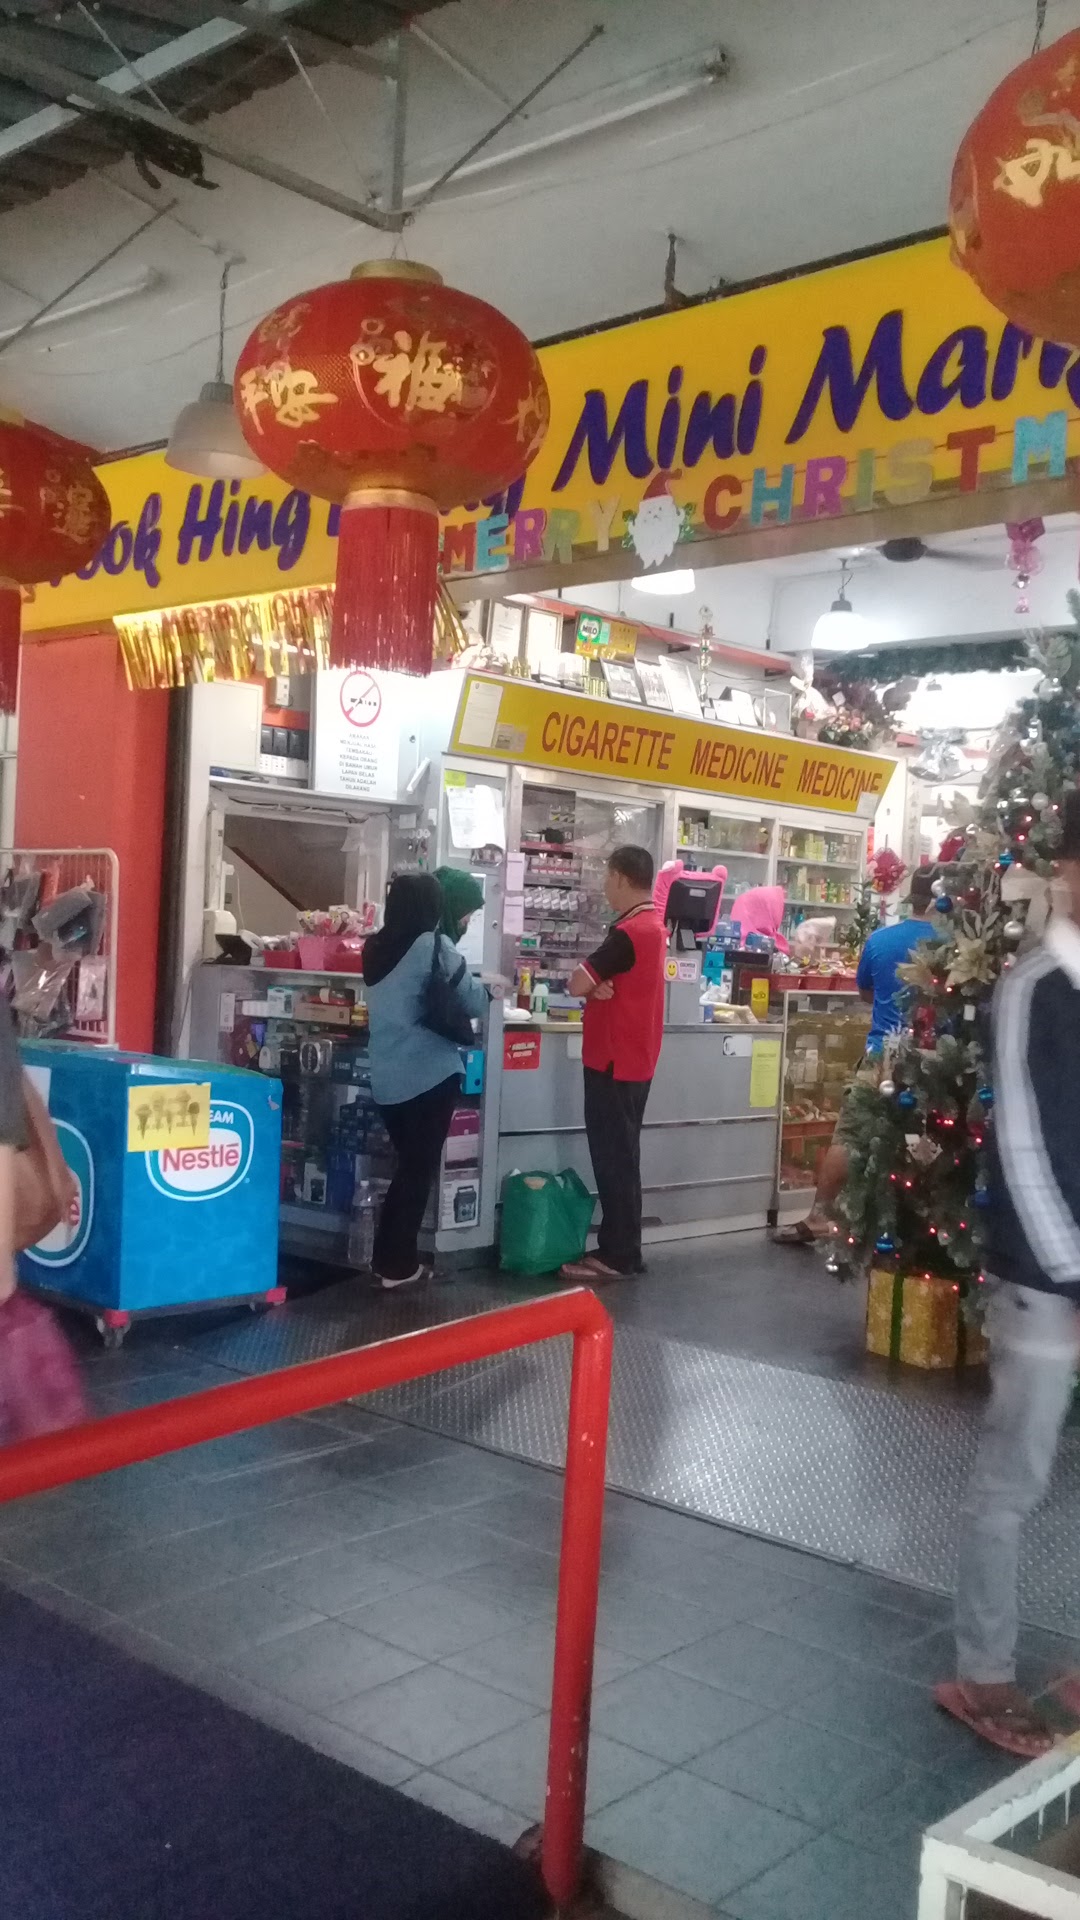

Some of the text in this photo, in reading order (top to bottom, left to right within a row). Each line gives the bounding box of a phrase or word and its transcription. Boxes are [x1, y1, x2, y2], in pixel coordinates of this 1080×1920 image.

[50, 492, 163, 588] ok
[177, 479, 311, 571] Hing
[551, 344, 768, 492] Mini
[441, 494, 620, 576] MERRY
[582, 625, 598, 635] MILO
[541, 711, 676, 771] CIGARETTE
[690, 738, 789, 788] MEDICINE
[797, 759, 883, 801] MEDICINE
